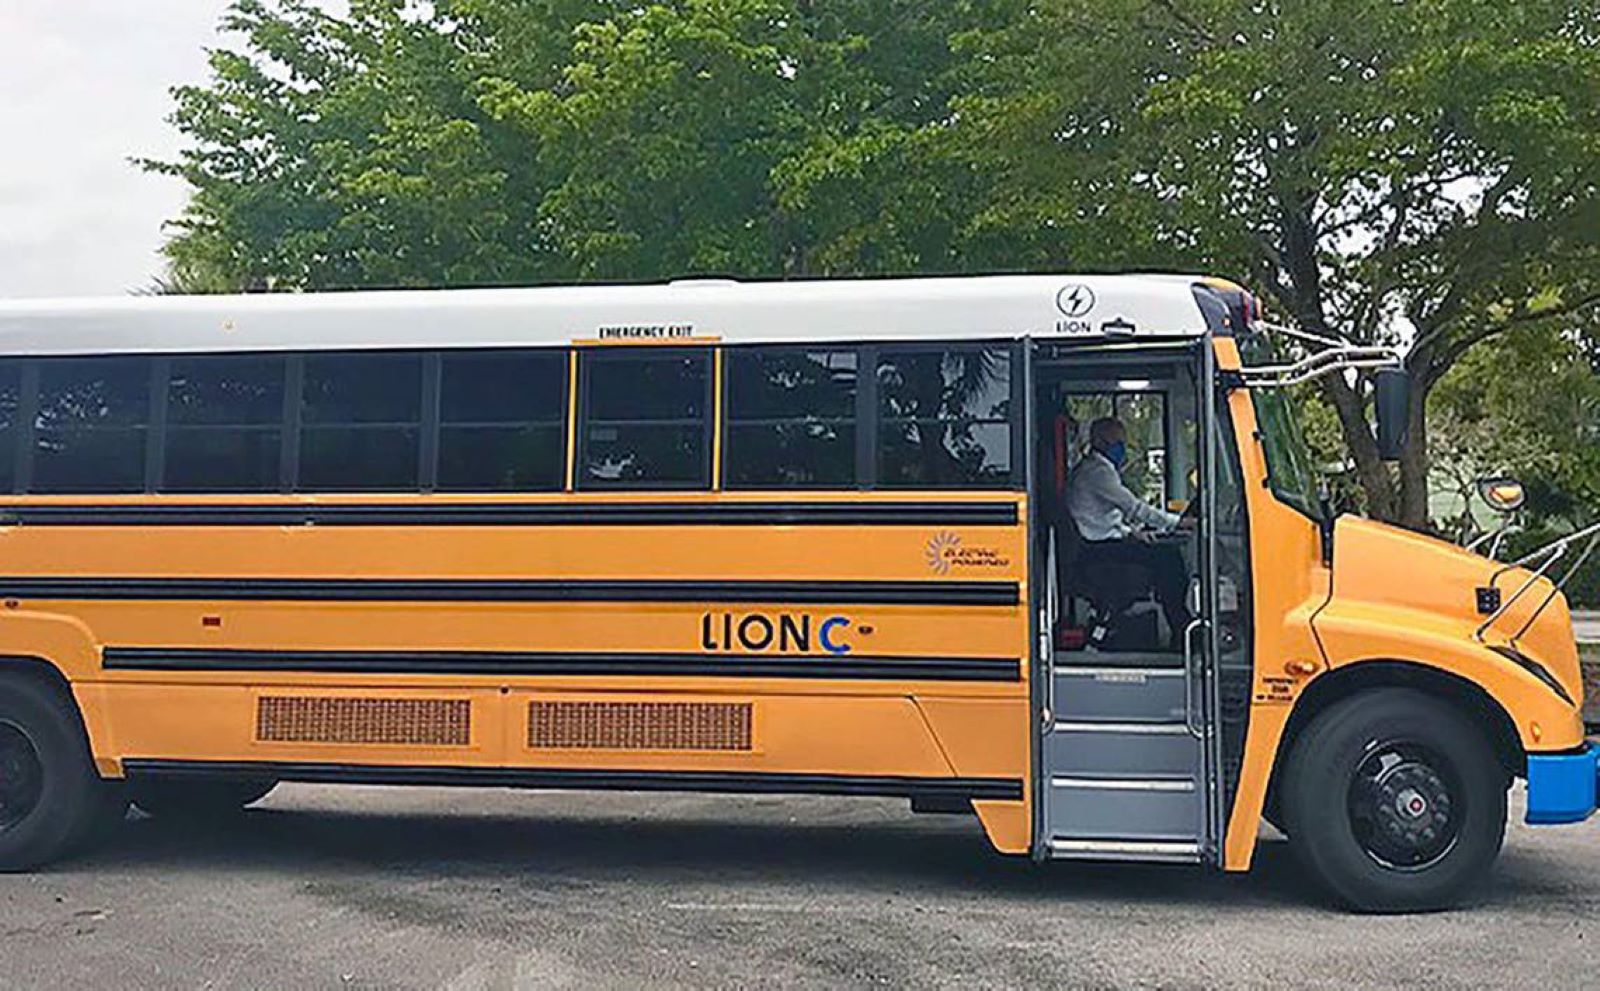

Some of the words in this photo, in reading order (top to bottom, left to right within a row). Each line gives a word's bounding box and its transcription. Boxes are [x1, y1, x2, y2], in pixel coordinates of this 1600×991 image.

[599, 326, 665, 339] EMERGENCY
[668, 325, 693, 338] EXIT
[1056, 321, 1091, 333] LION
